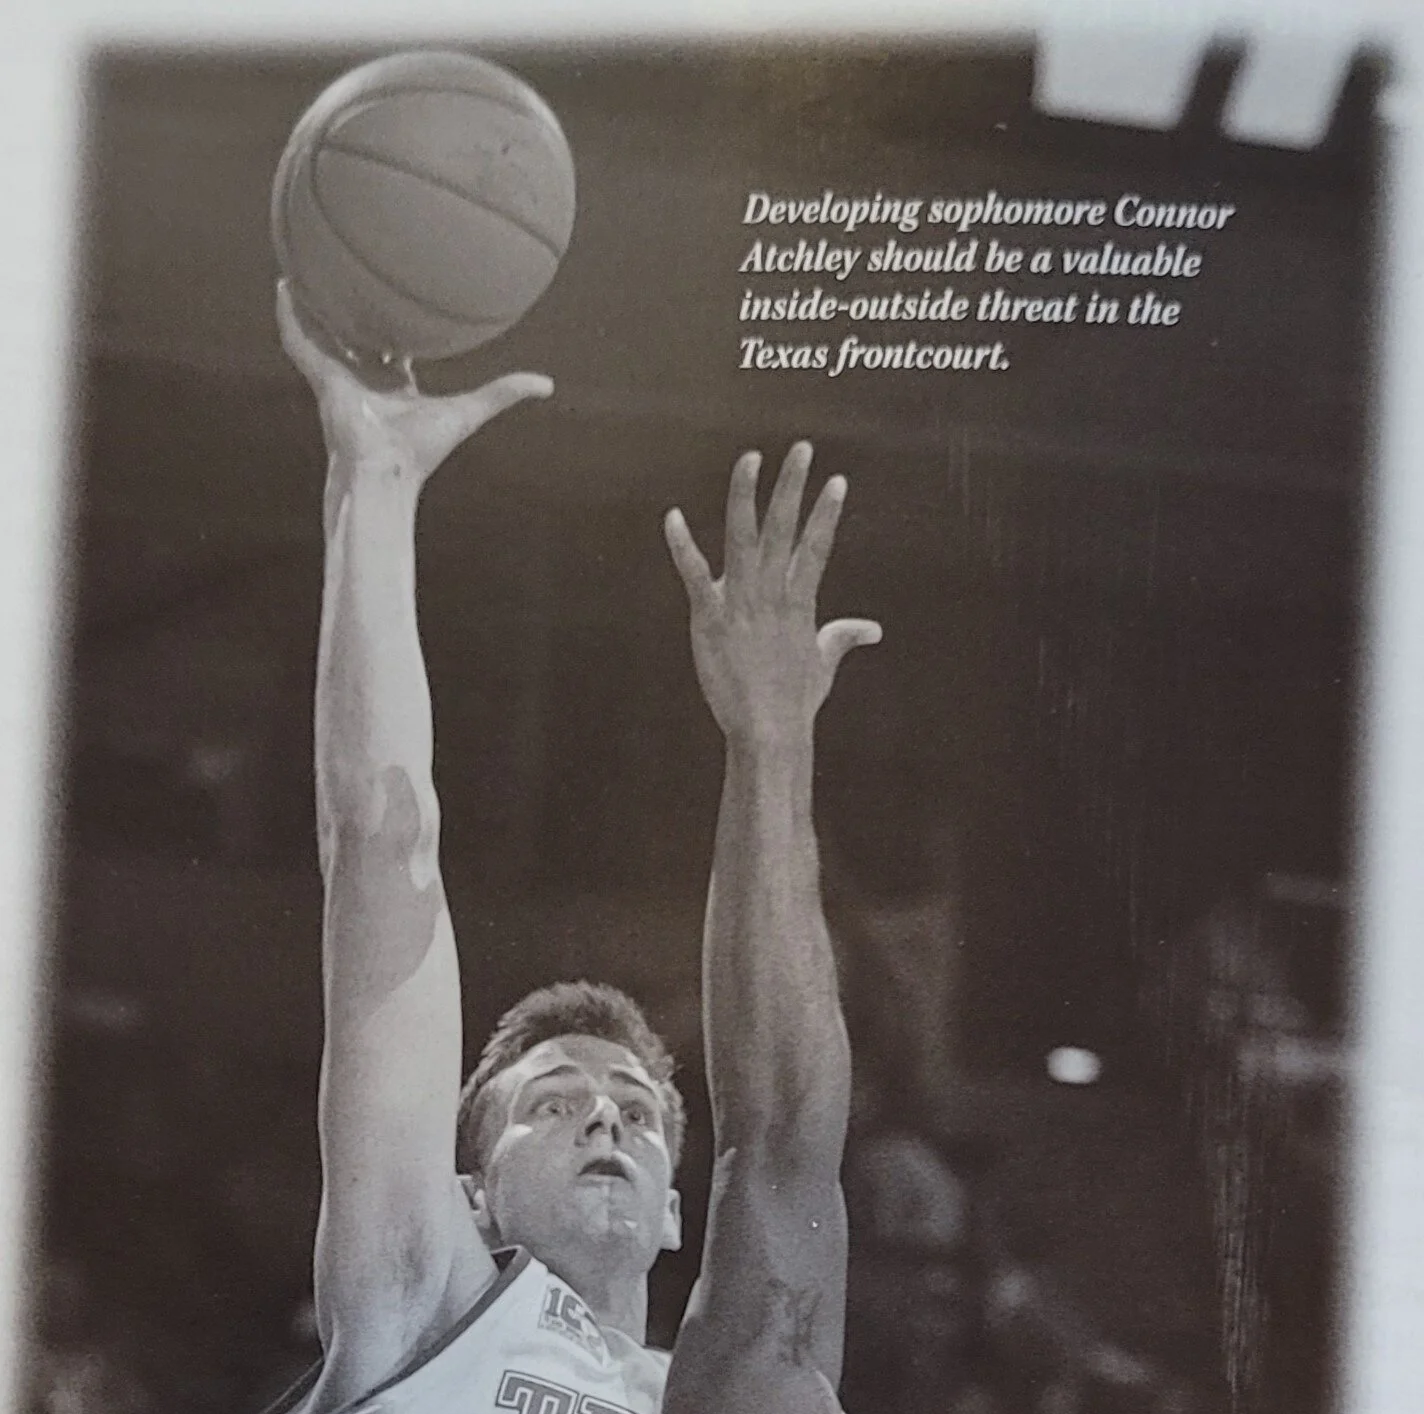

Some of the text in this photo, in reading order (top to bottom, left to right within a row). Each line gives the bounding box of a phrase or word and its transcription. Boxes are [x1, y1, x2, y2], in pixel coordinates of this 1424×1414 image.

[743, 191, 1234, 232] Developing sophomore Connor
[738, 239, 1201, 280] Atchley should be a valuable
[739, 287, 1180, 325] inside-outside threat in the
[739, 336, 1009, 377] Texas frontcourt.
